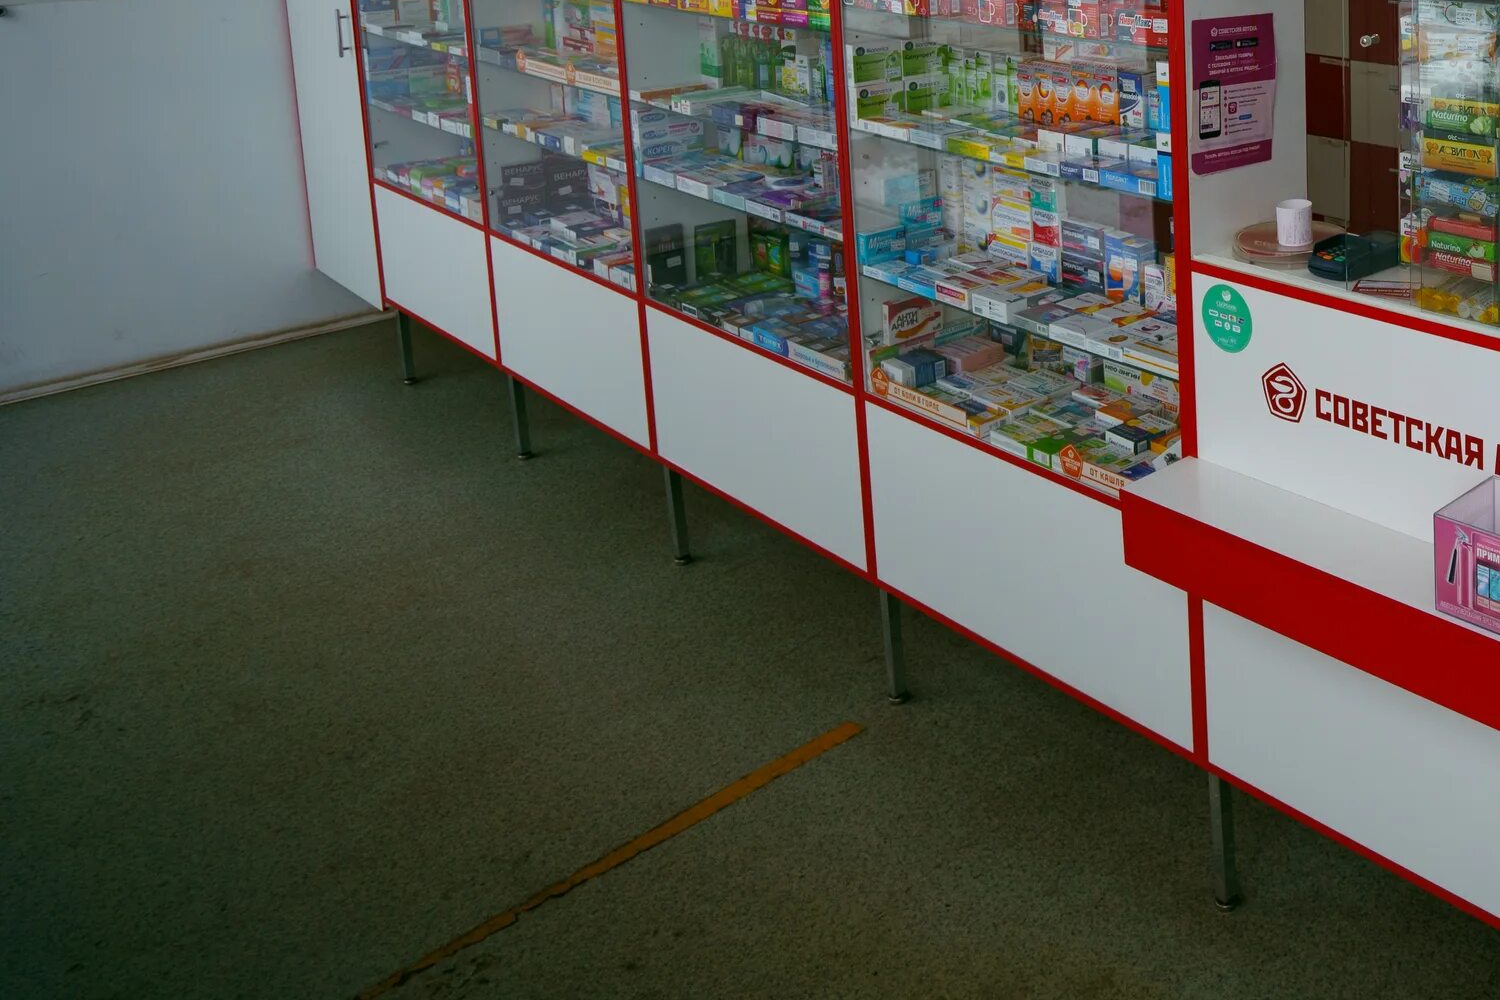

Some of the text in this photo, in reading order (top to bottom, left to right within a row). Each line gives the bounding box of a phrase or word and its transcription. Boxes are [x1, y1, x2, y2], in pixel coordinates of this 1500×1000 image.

[1315, 388, 1483, 471] СОВЕТСКАЯ
[1089, 468, 1125, 488] ОТ КАШЛЯ
